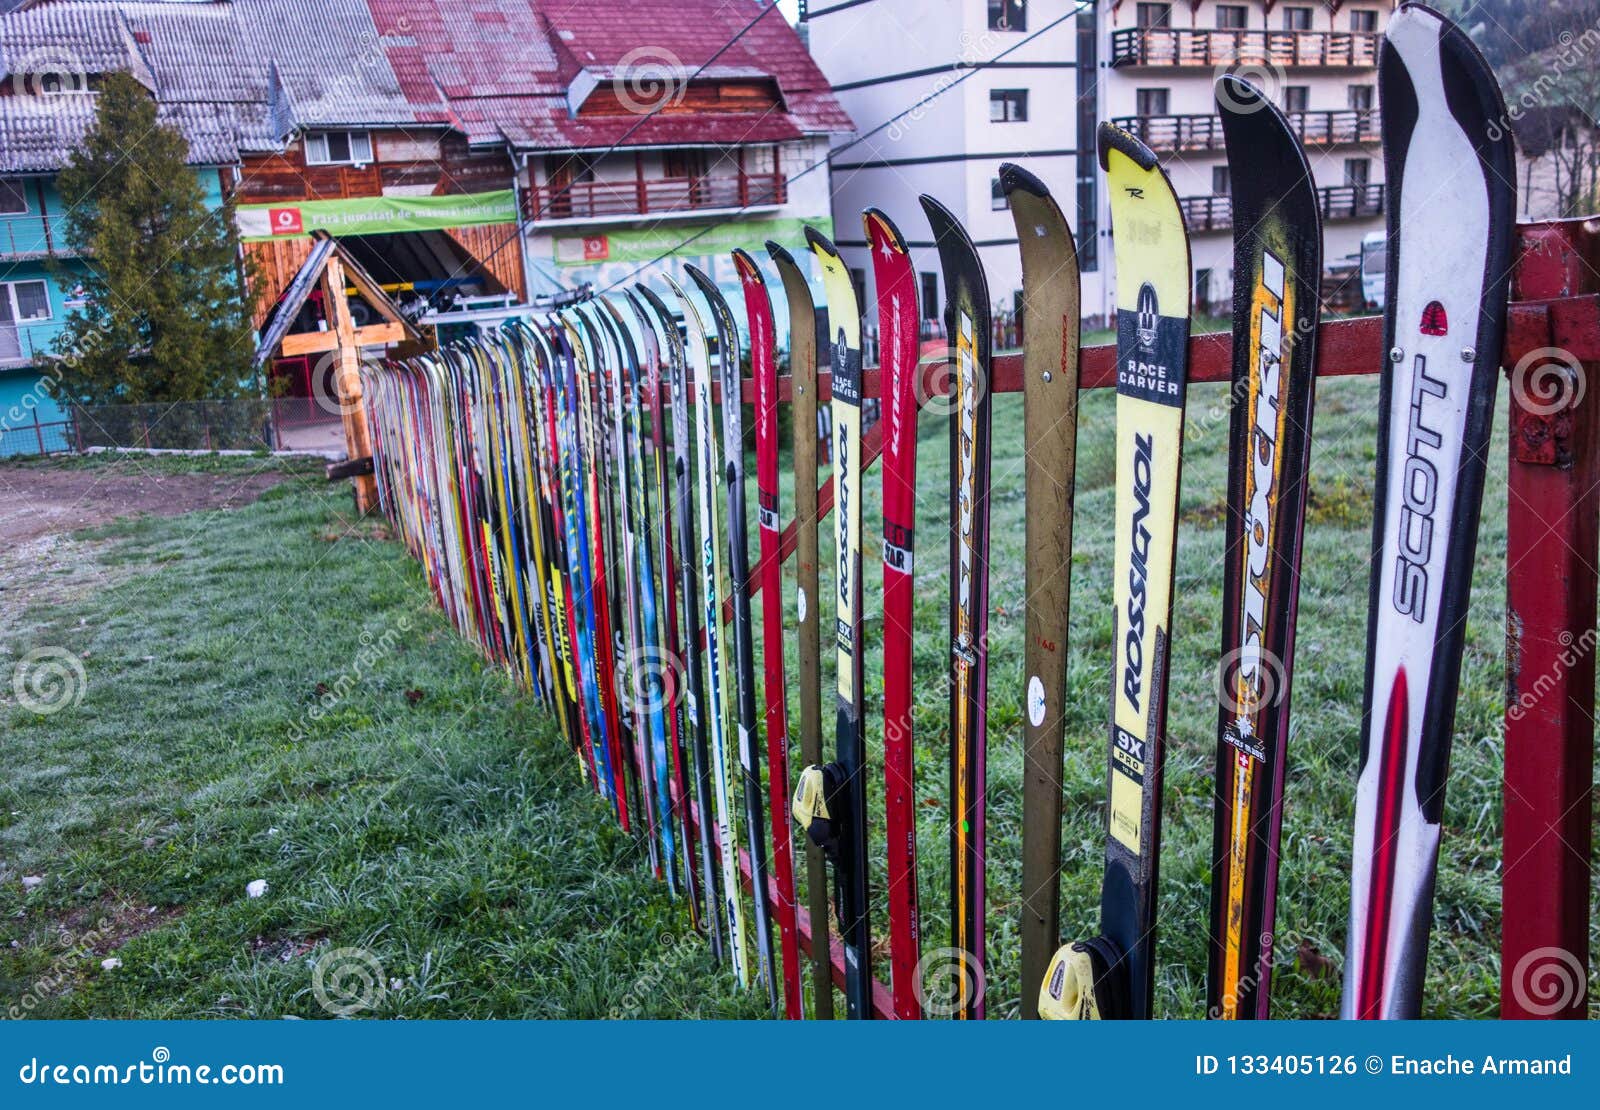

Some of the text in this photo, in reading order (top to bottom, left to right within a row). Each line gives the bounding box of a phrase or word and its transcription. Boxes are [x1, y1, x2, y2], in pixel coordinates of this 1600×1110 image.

[1119, 371, 1178, 395] CARVER
[1128, 359, 1166, 378] RACE
[1392, 353, 1448, 623] SCOTT
[840, 423, 848, 607] ROSSIGNOL
[1124, 432, 1152, 714] ROSSIGNOL
[535, 602, 547, 645] ATOMIC
[1117, 730, 1142, 760] 9X
[1118, 751, 1139, 770] PRO
